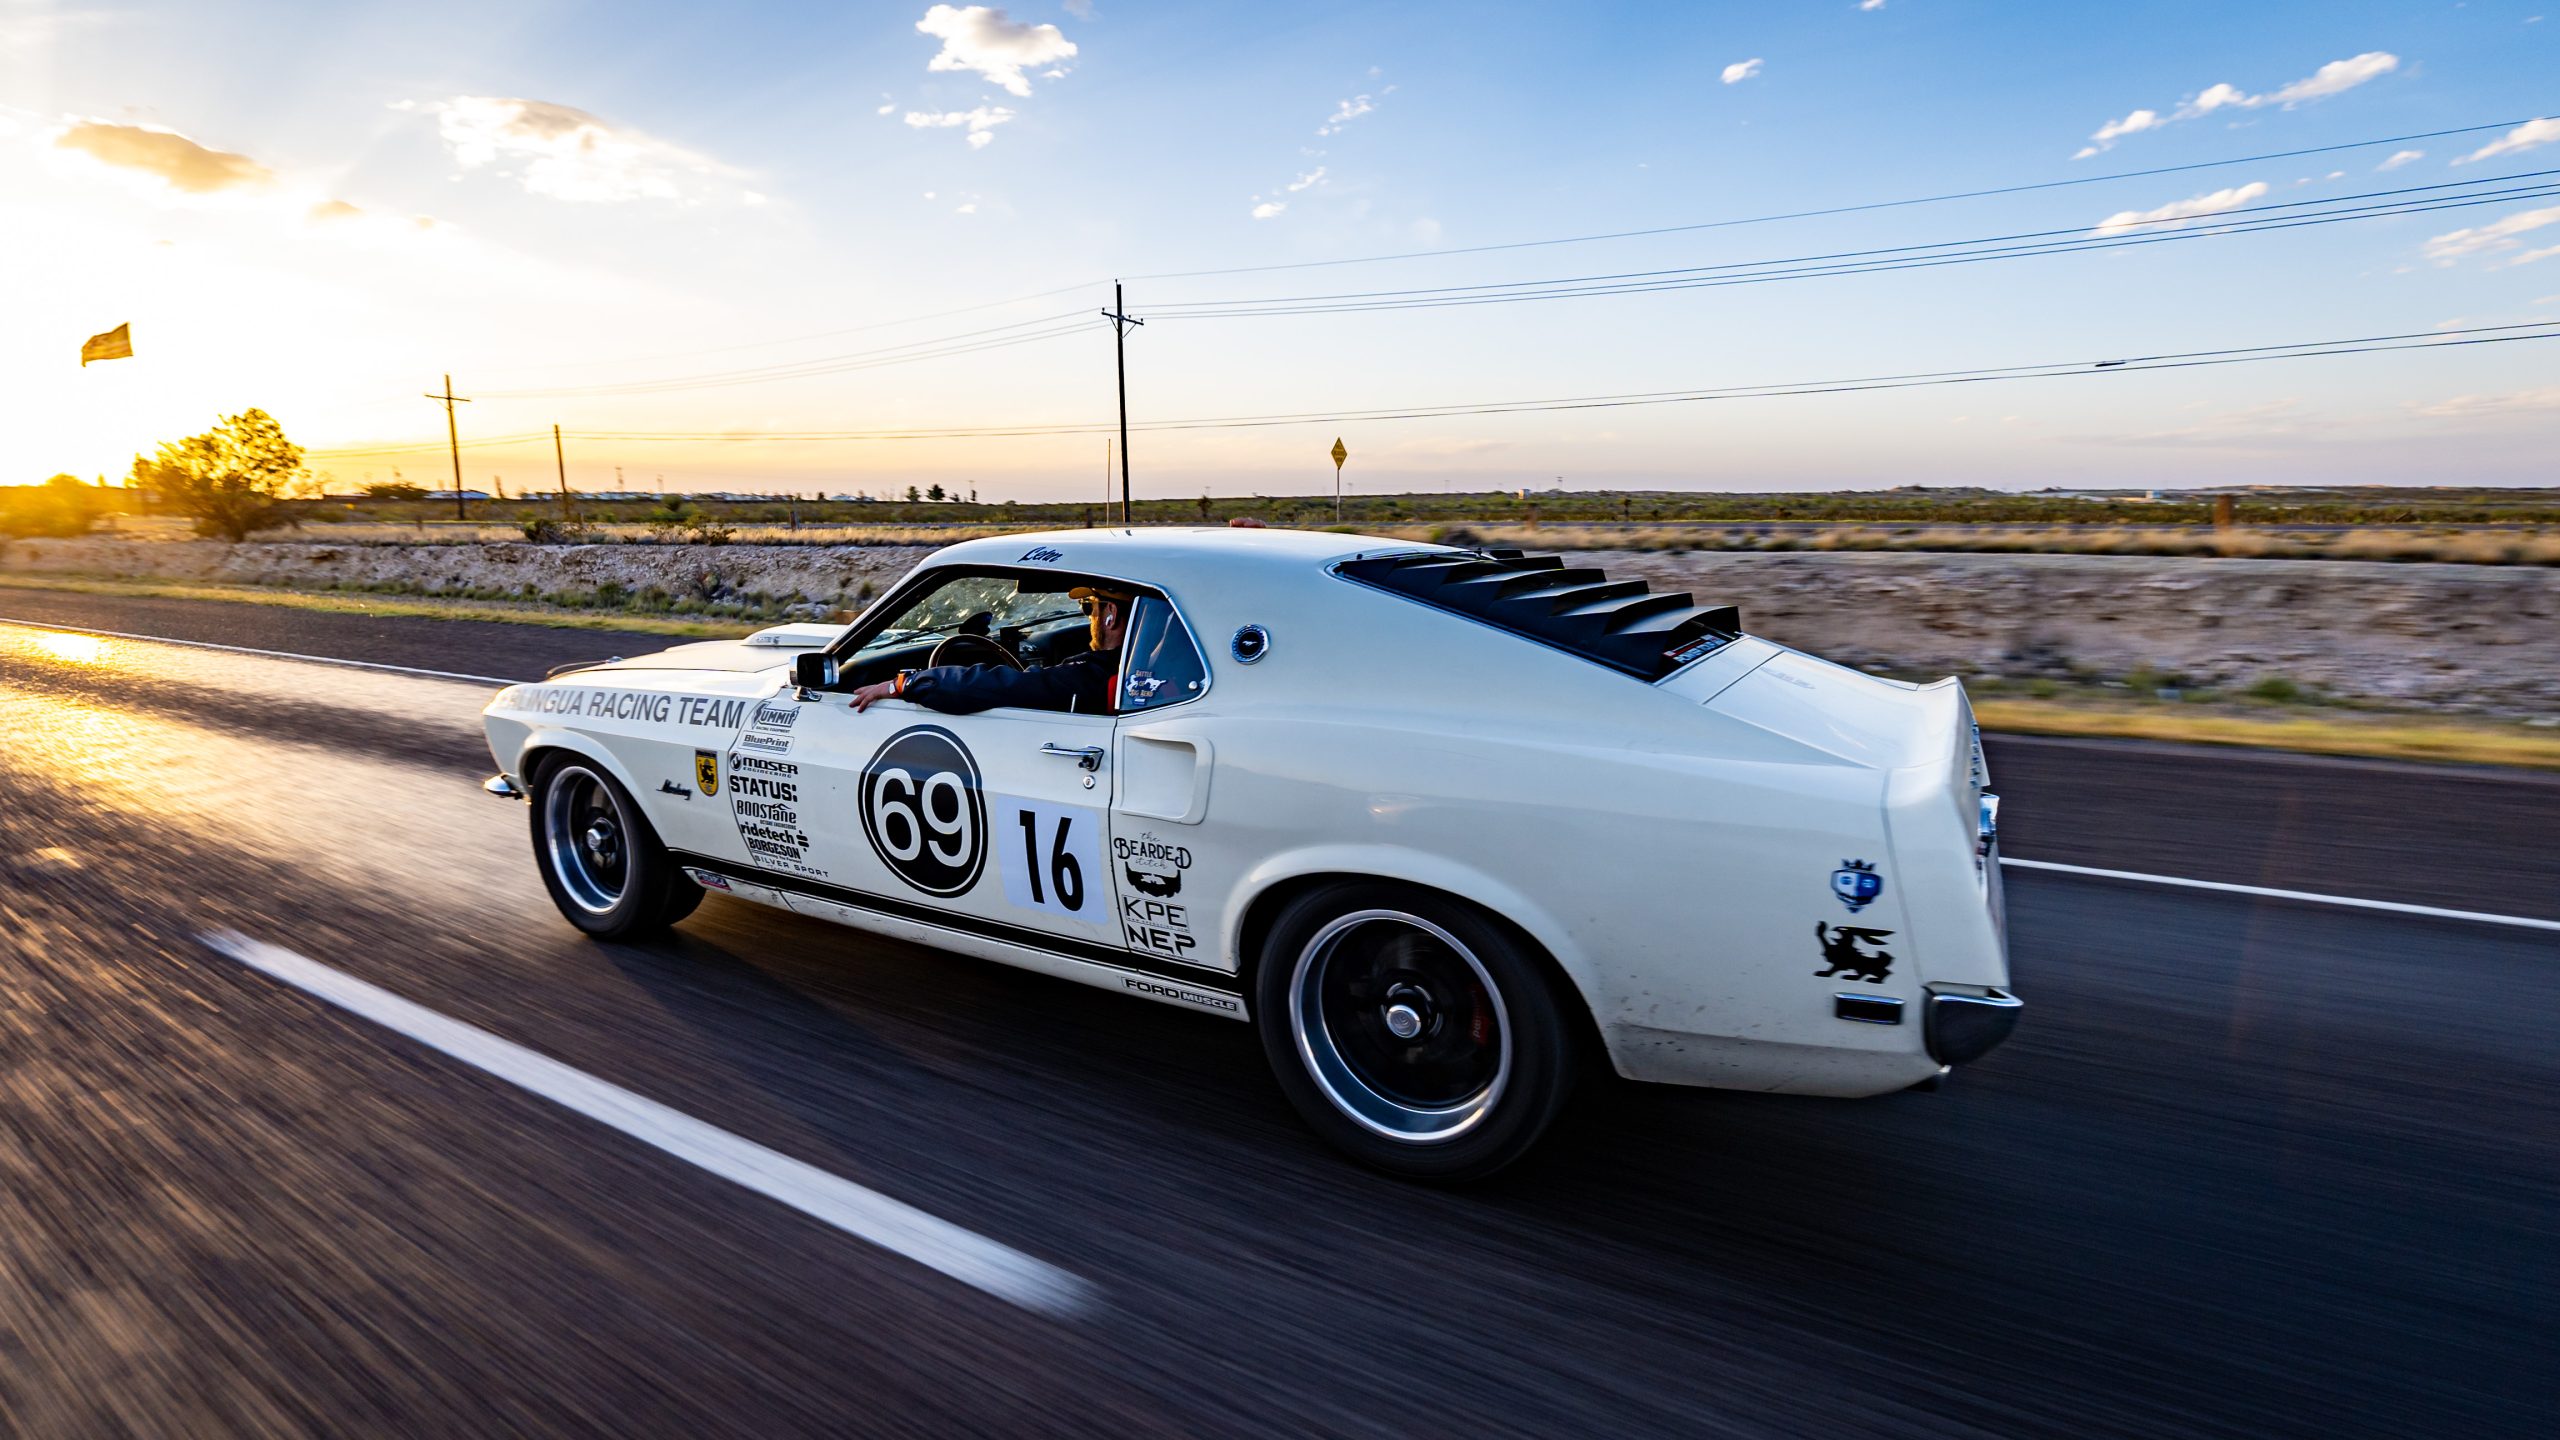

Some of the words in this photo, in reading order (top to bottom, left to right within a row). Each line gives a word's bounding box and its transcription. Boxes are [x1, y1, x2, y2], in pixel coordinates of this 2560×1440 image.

[586, 691, 671, 722] RACING
[678, 697, 746, 729] TEAM
[752, 702, 801, 729] SUMMIT
[744, 734, 790, 748] BluePrint
[743, 757, 798, 775] MOSER
[743, 766, 791, 779] ENGINEERING
[873, 767, 972, 868] 69
[740, 821, 795, 844] ridetech
[1140, 831, 1160, 842] the
[747, 836, 801, 859] BORGESON
[1019, 809, 1084, 912] 16
[1113, 837, 1192, 870] BEARDED
[754, 855, 790, 868] SILVER
[794, 864, 829, 878] SPORT
[1123, 896, 1187, 928] KPE
[1127, 923, 1196, 956] NEP
[1125, 979, 1180, 999] FORD
[1182, 991, 1237, 1012] MUSCLE
